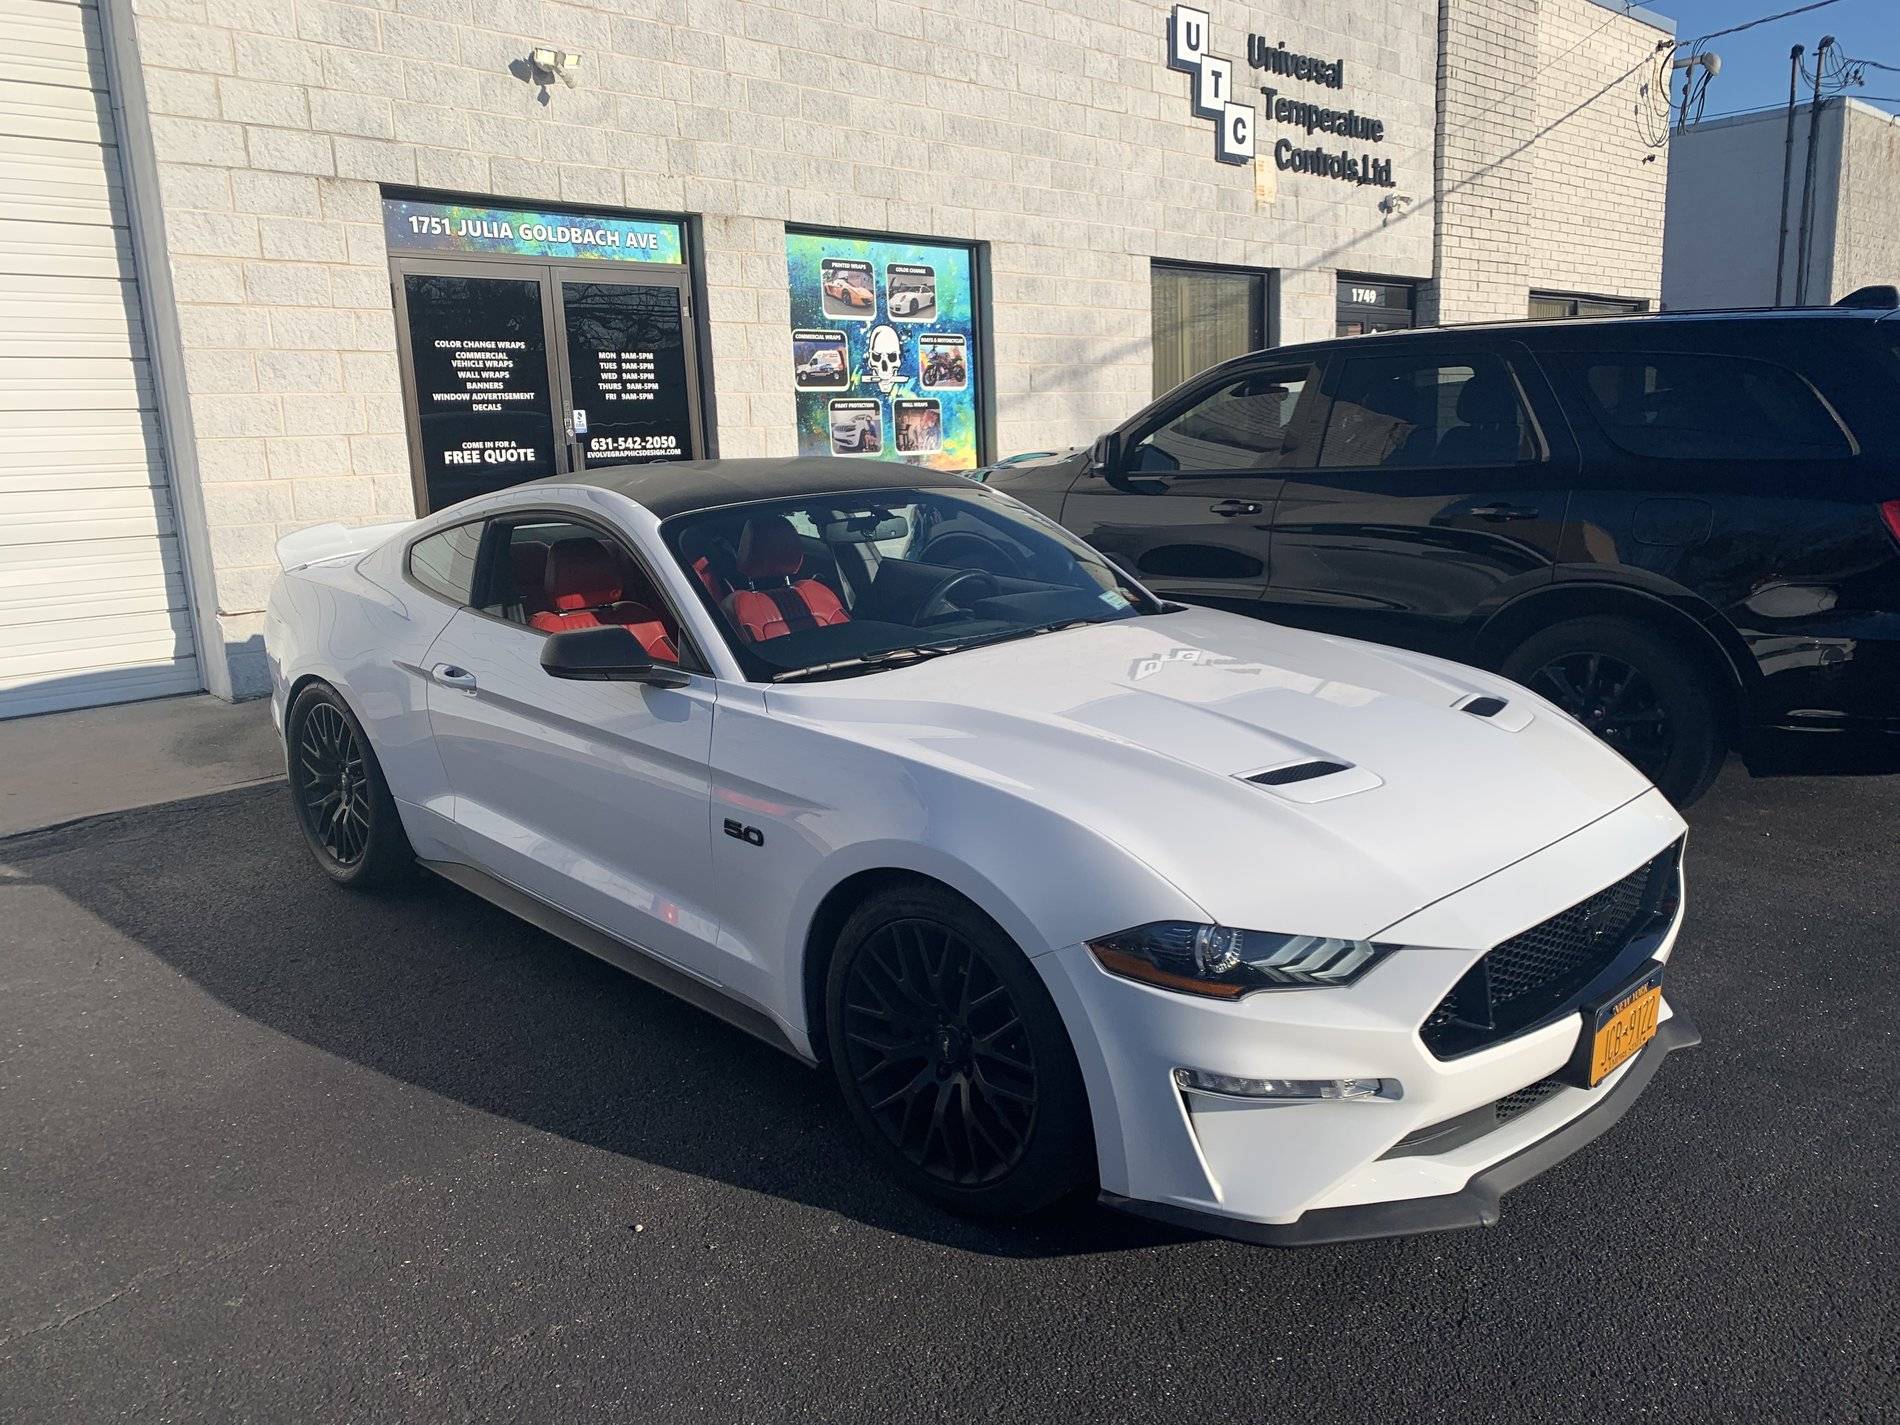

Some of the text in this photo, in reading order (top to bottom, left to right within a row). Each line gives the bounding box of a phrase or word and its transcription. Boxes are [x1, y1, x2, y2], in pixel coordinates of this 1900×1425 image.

[1247, 33, 1344, 90] Universal
[1260, 86, 1384, 143] Temperature
[409, 216, 659, 249] 1751 JULIA GOLDBACH AVE
[1352, 288, 1377, 303] 1749
[434, 340, 462, 348] COLOR
[455, 352, 508, 360] COMMERCIAL
[621, 352, 654, 360] 9AM-5PM
[451, 360, 513, 368] VEHICLE WRAPS
[599, 362, 654, 370] TUES 9AM-5PM
[457, 371, 510, 379] WALL WRAPS
[600, 372, 655, 380] WED 9AM-5PM
[466, 382, 504, 390] BANNERS
[432, 392, 535, 401] WINDOW ADVERTISEMENT
[472, 403, 502, 411] DECALS
[461, 441, 484, 449] COME
[590, 436, 676, 450] 631-542-2050
[444, 448, 536, 464] FREE QUOTE
[587, 448, 682, 459] EVOLVEGRAPHICSDESIGN.COM
